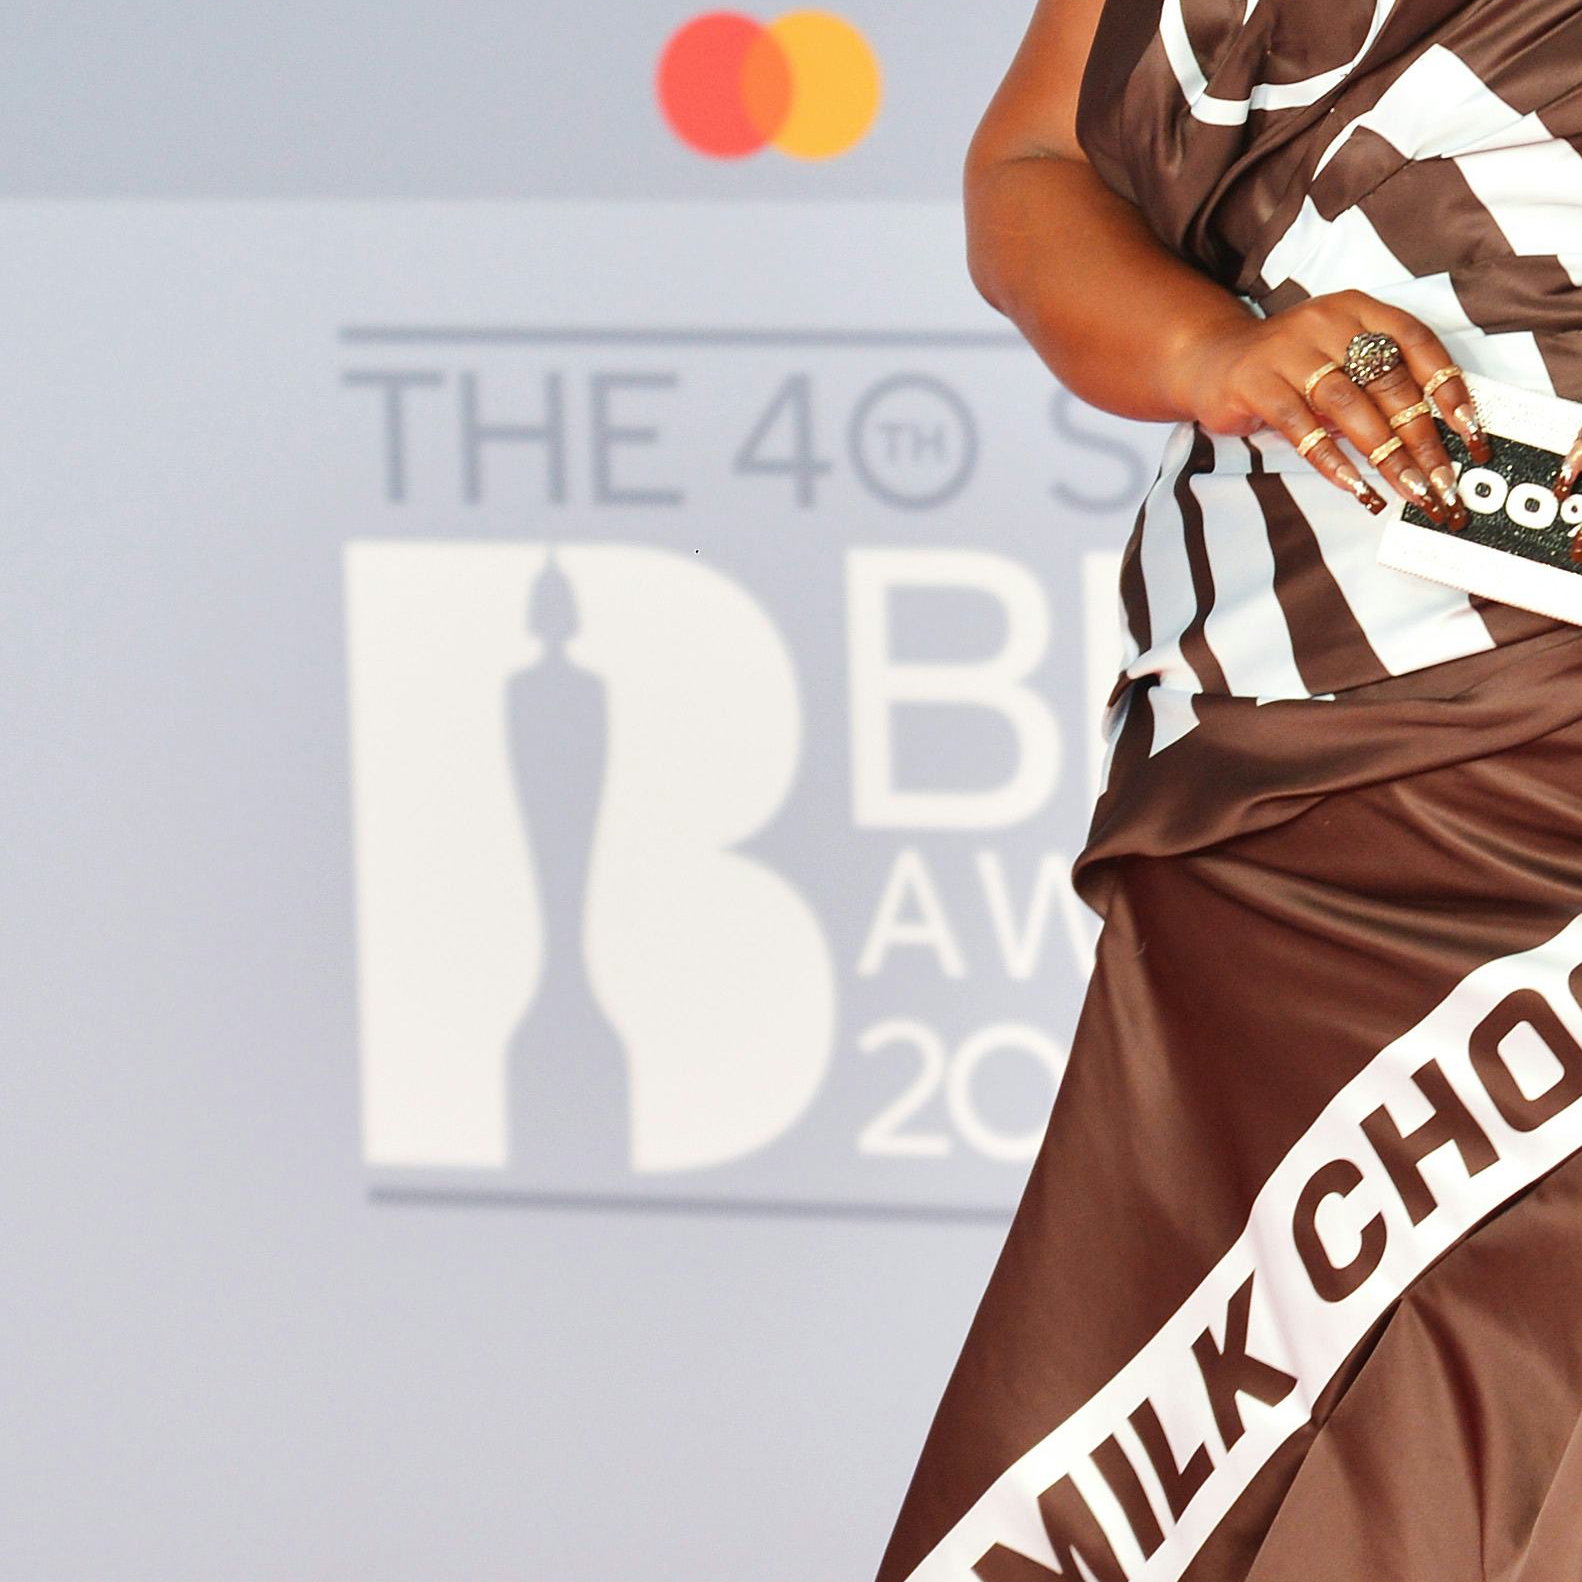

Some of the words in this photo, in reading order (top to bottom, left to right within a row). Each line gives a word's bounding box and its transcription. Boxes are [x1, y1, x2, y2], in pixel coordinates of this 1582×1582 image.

[340, 369, 686, 509] THE
[731, 369, 981, 513] 40
[856, 1019, 1068, 1160] 20
